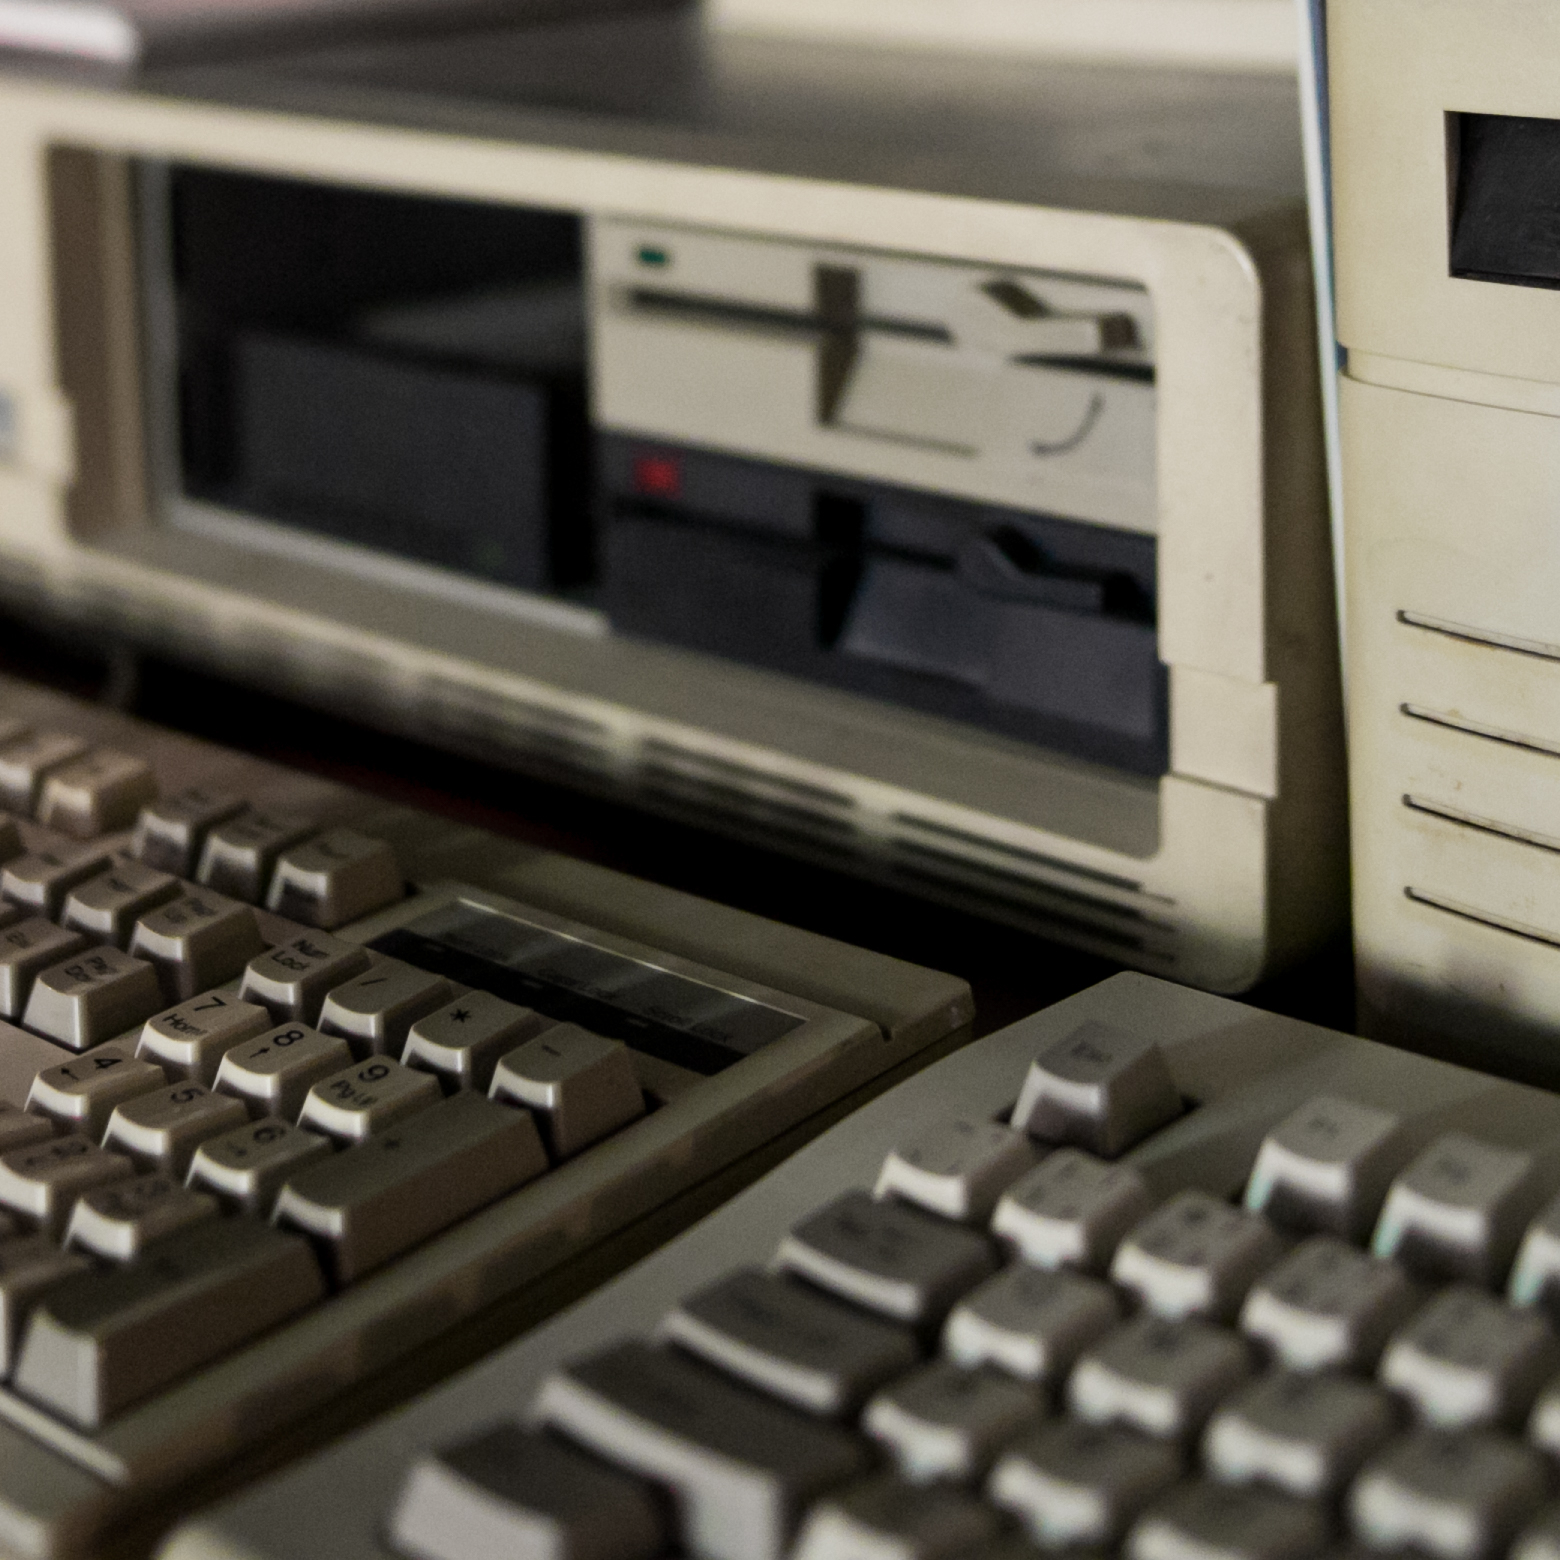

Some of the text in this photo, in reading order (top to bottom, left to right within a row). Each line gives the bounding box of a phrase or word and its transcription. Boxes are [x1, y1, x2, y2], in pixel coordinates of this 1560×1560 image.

[194, 996, 228, 1014] 7
[272, 1028, 306, 1048] 8
[93, 1055, 123, 1071] 4
[357, 1063, 391, 1084] 9
[170, 1086, 204, 1105] 5
